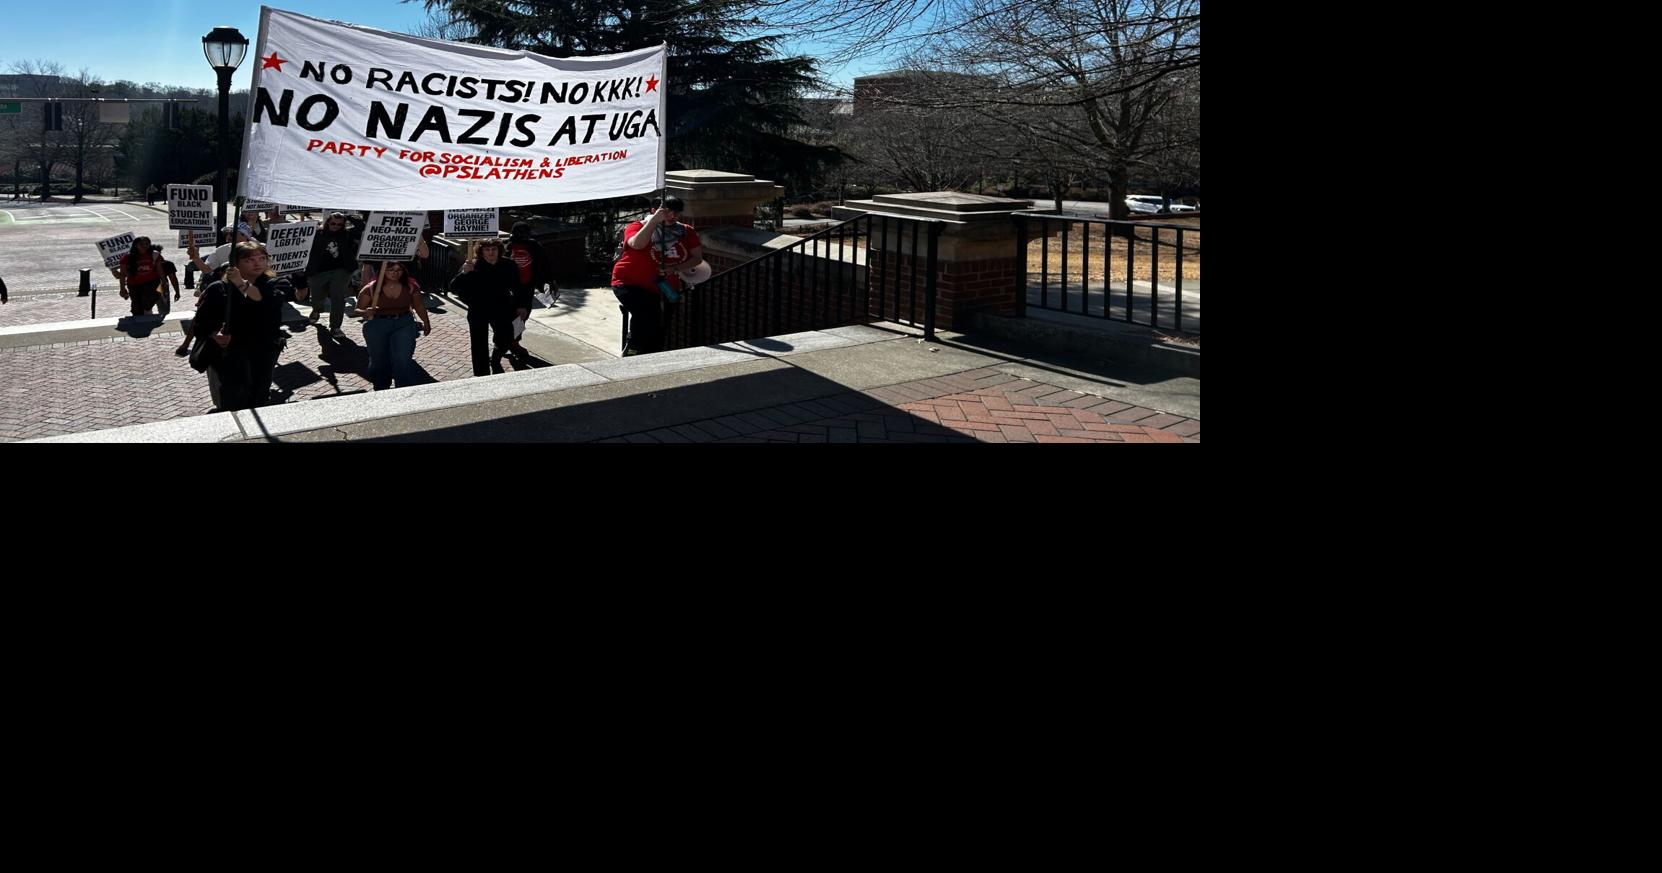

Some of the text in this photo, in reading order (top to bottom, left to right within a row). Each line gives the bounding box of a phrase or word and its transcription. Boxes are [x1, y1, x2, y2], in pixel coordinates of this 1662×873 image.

[300, 60, 643, 104] NO RACISTS! NO KKK!
[253, 87, 661, 147] NO NAZIS AT UGA
[307, 139, 627, 168] PARTY FOR SOCIALISM & LIBERATION
[419, 164, 565, 180] @PSLATHENS
[170, 188, 208, 200] FUND
[170, 209, 210, 219] STUDENT
[381, 216, 412, 227] FIRE
[270, 226, 314, 240] DEFEND
[370, 226, 418, 234] NEO-NAZI
[181, 232, 216, 240] STDENTS
[367, 234, 416, 242] ORGANIZER
[99, 234, 133, 250] FUND
[109, 244, 130, 253] BLACK
[270, 250, 308, 261] TUDENTS
